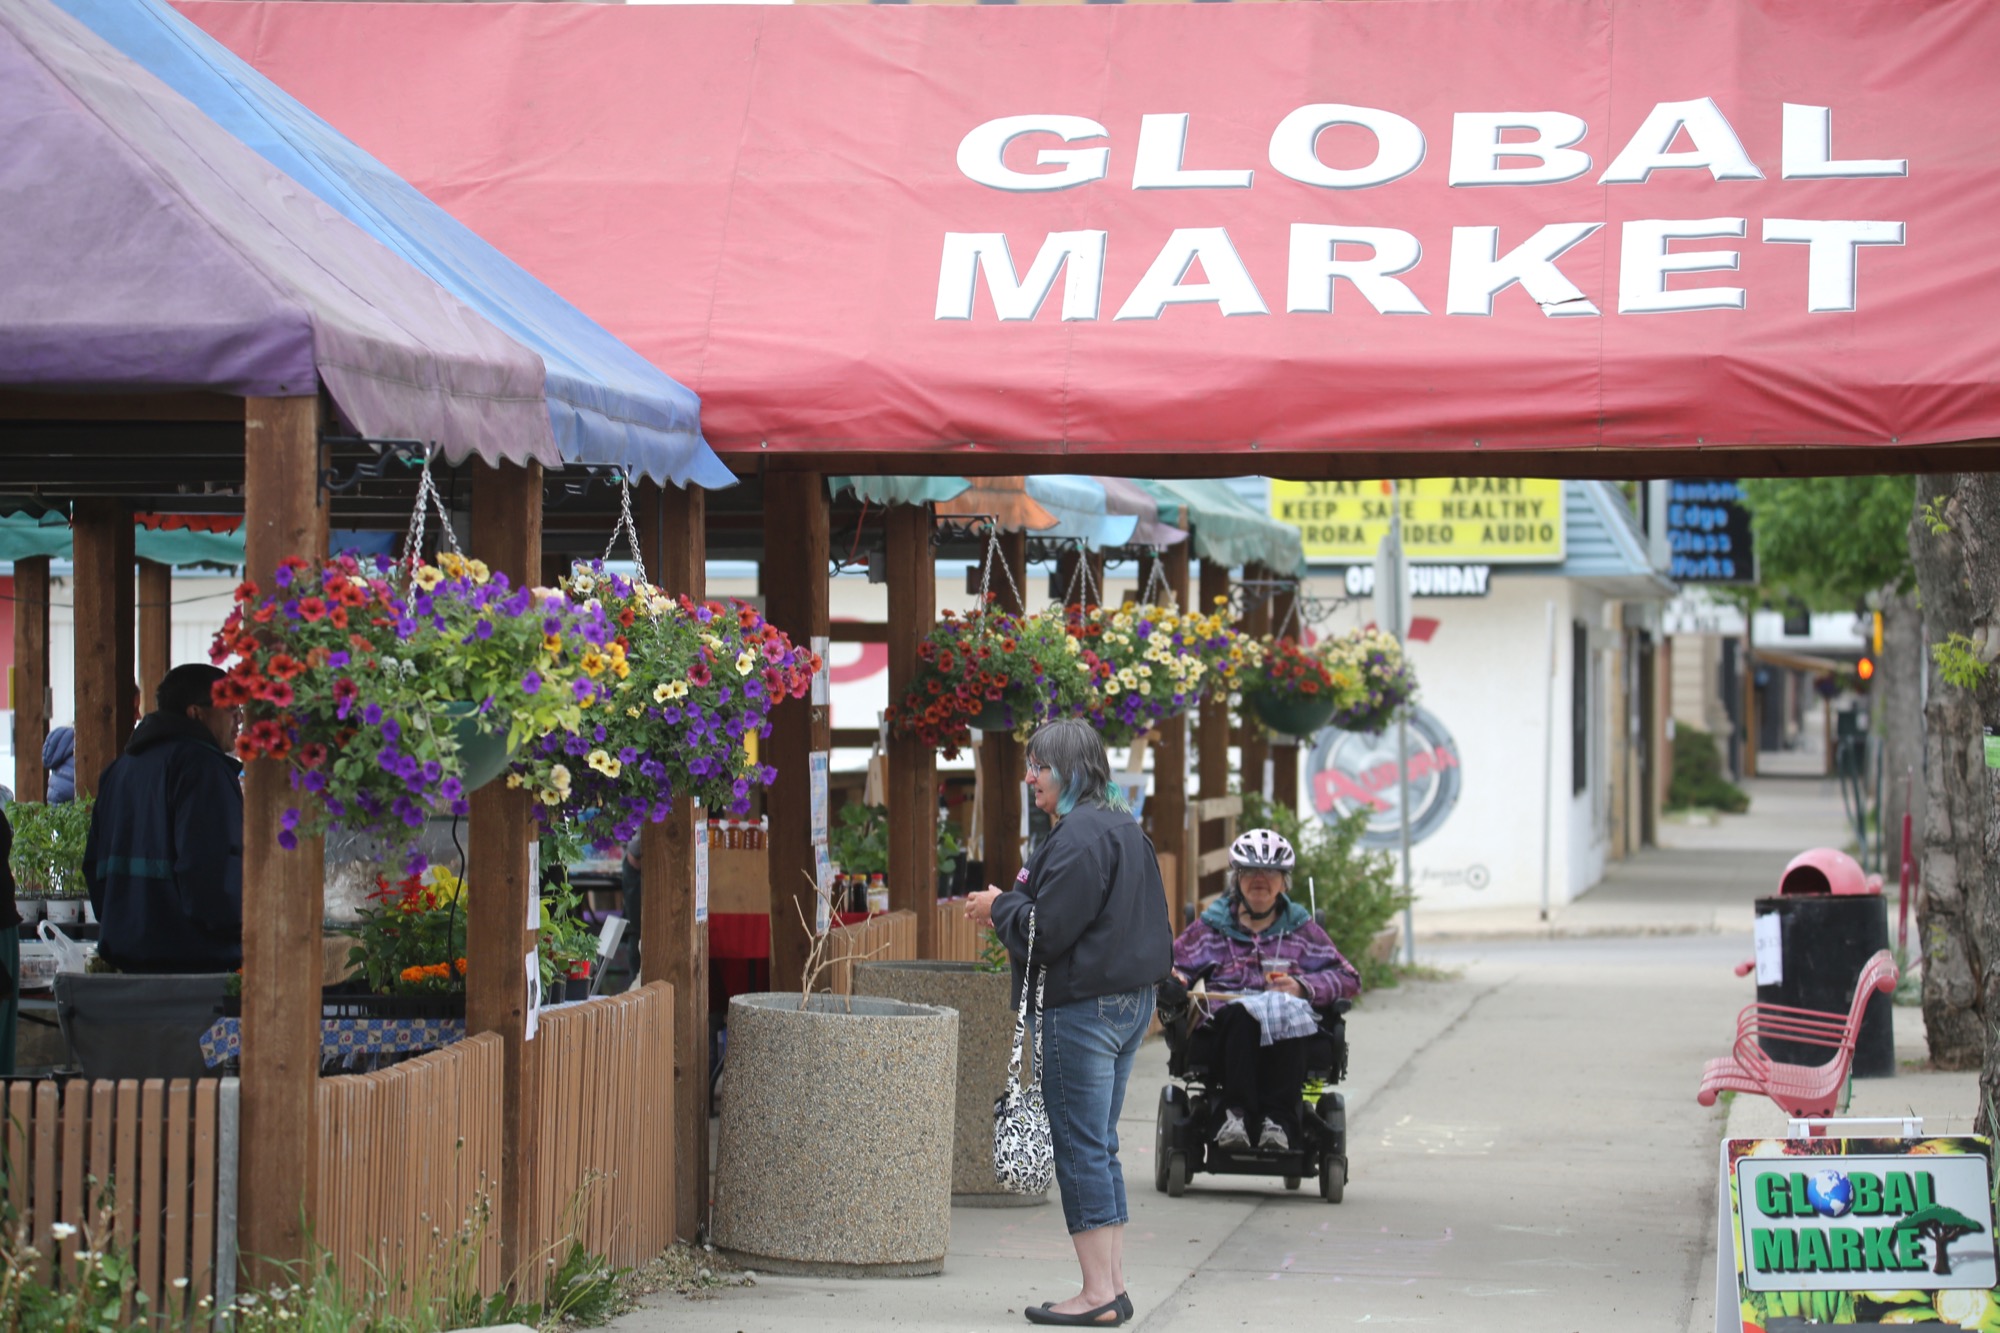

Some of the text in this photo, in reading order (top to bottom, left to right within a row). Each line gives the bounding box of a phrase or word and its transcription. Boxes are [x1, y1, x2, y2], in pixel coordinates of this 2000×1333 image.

[954, 96, 1909, 194] GLOBAL
[932, 217, 1906, 323] MARKET
[1306, 480, 1361, 496] STAY
[1451, 478, 1524, 494] APART
[1282, 501, 1544, 520] KEEP SAE HEALTHY
[1670, 504, 1729, 531] Edge
[1298, 524, 1554, 544] RORA IDEO AUDIO
[1409, 565, 1488, 595] SUNDAY
[1755, 1170, 1936, 1217] GLOBAL
